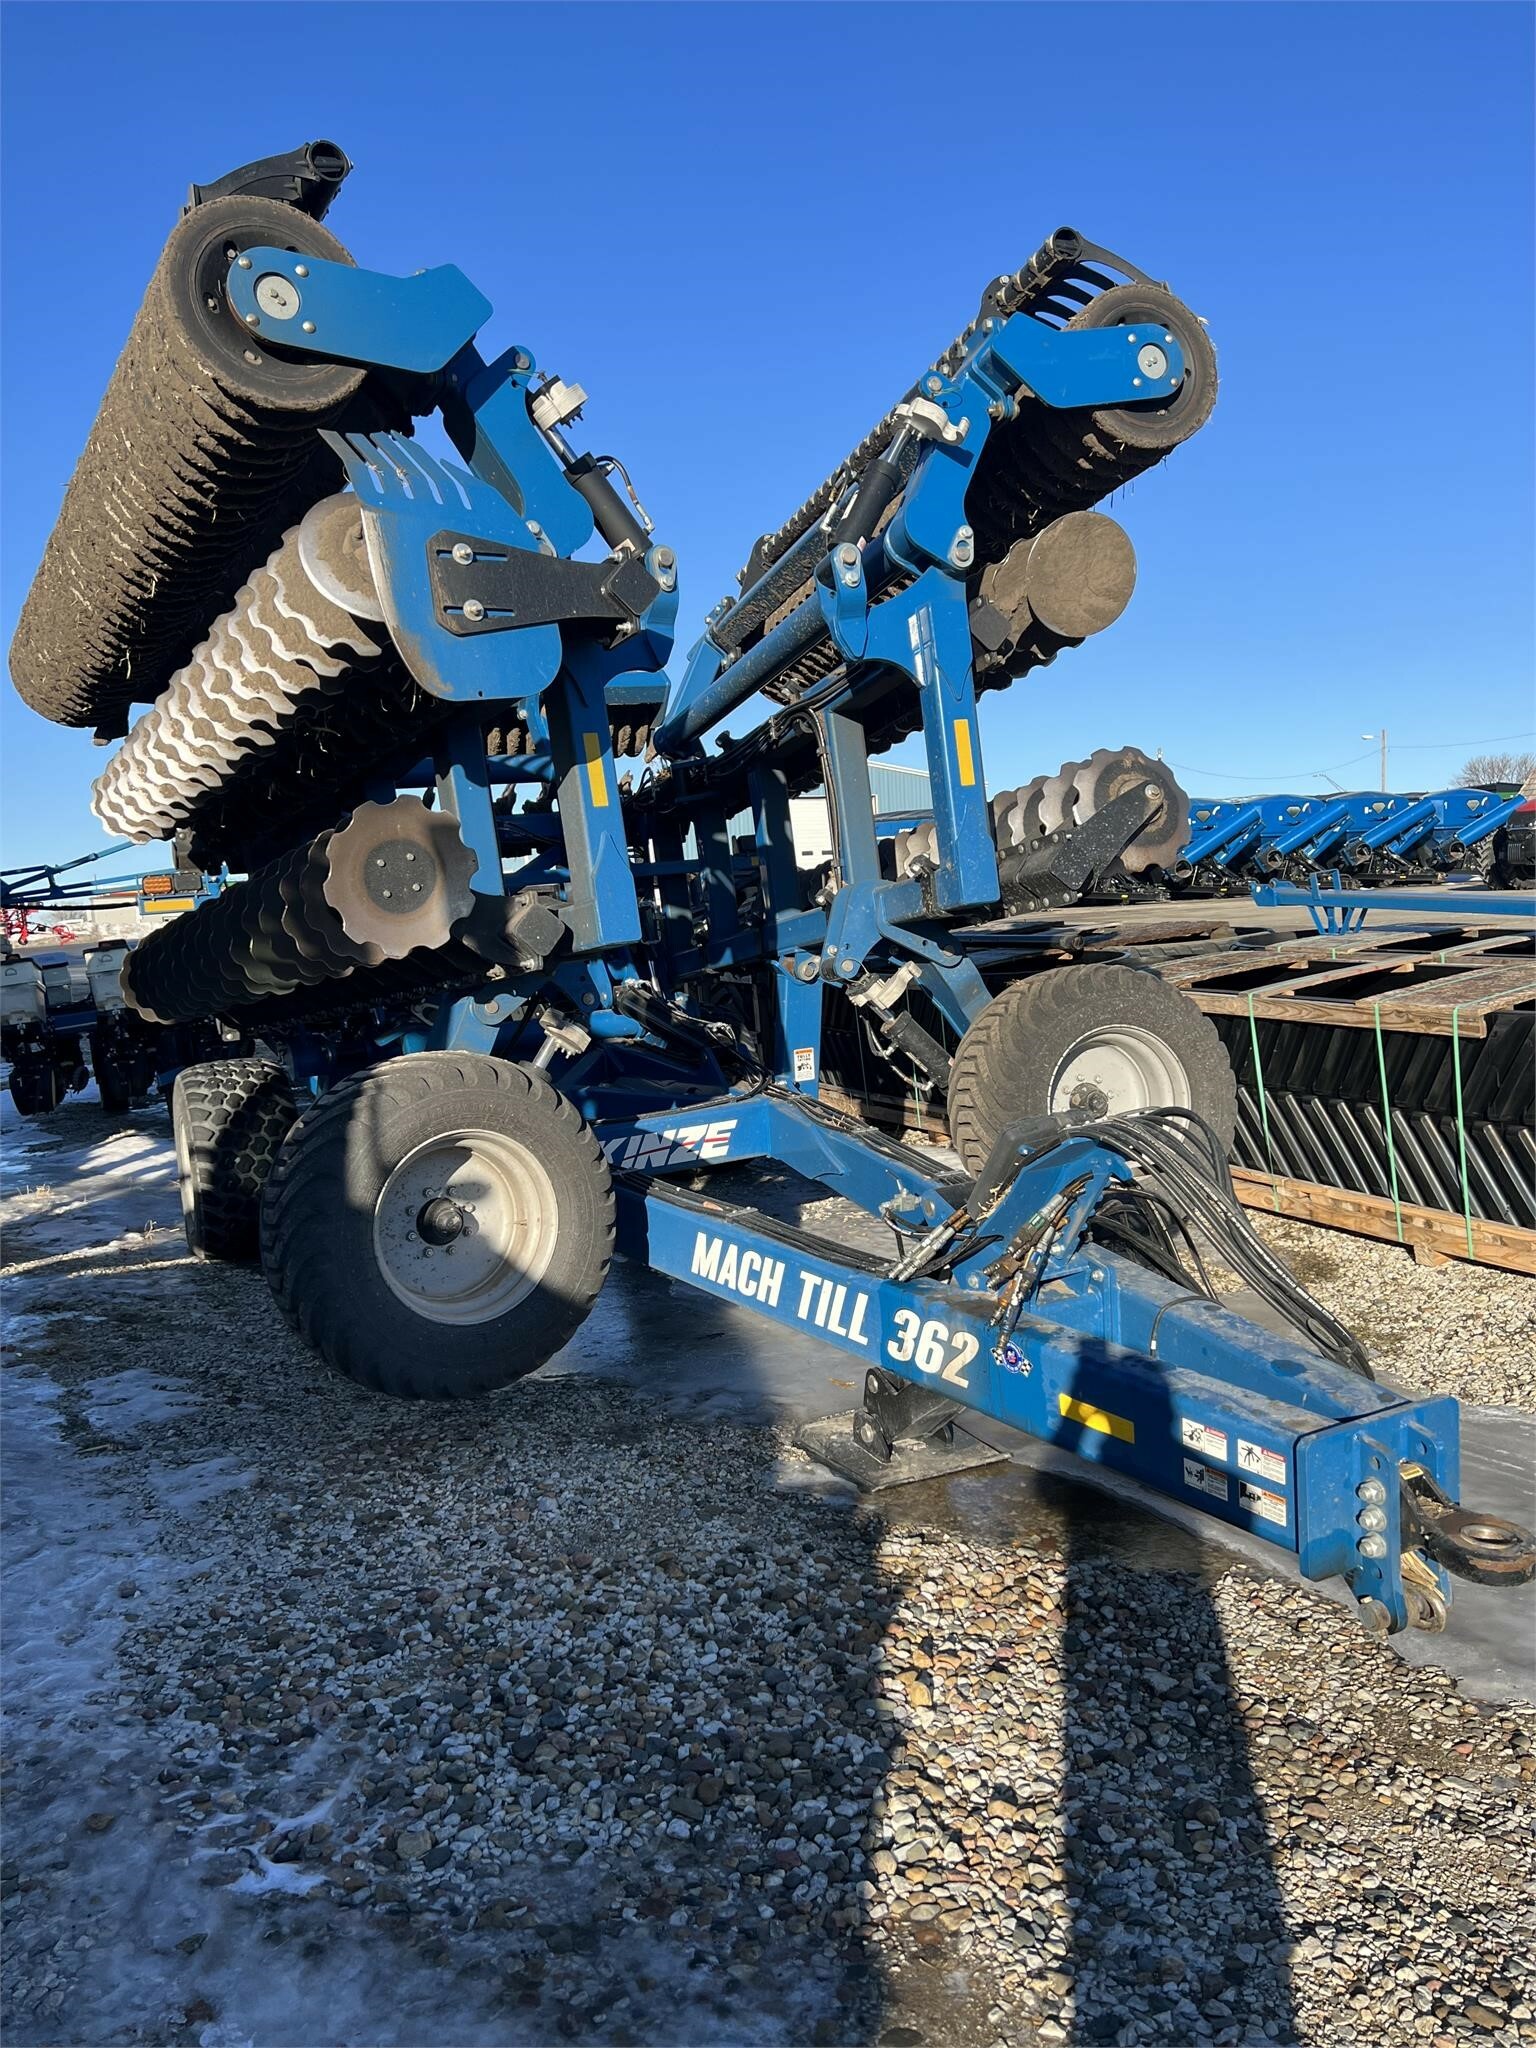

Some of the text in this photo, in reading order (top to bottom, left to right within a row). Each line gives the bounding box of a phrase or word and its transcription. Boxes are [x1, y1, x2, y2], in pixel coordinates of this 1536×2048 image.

[598, 1119, 738, 1170] KINZE
[690, 1231, 786, 1308] MACH
[797, 1270, 869, 1346] TILL
[887, 1308, 980, 1389] 362
